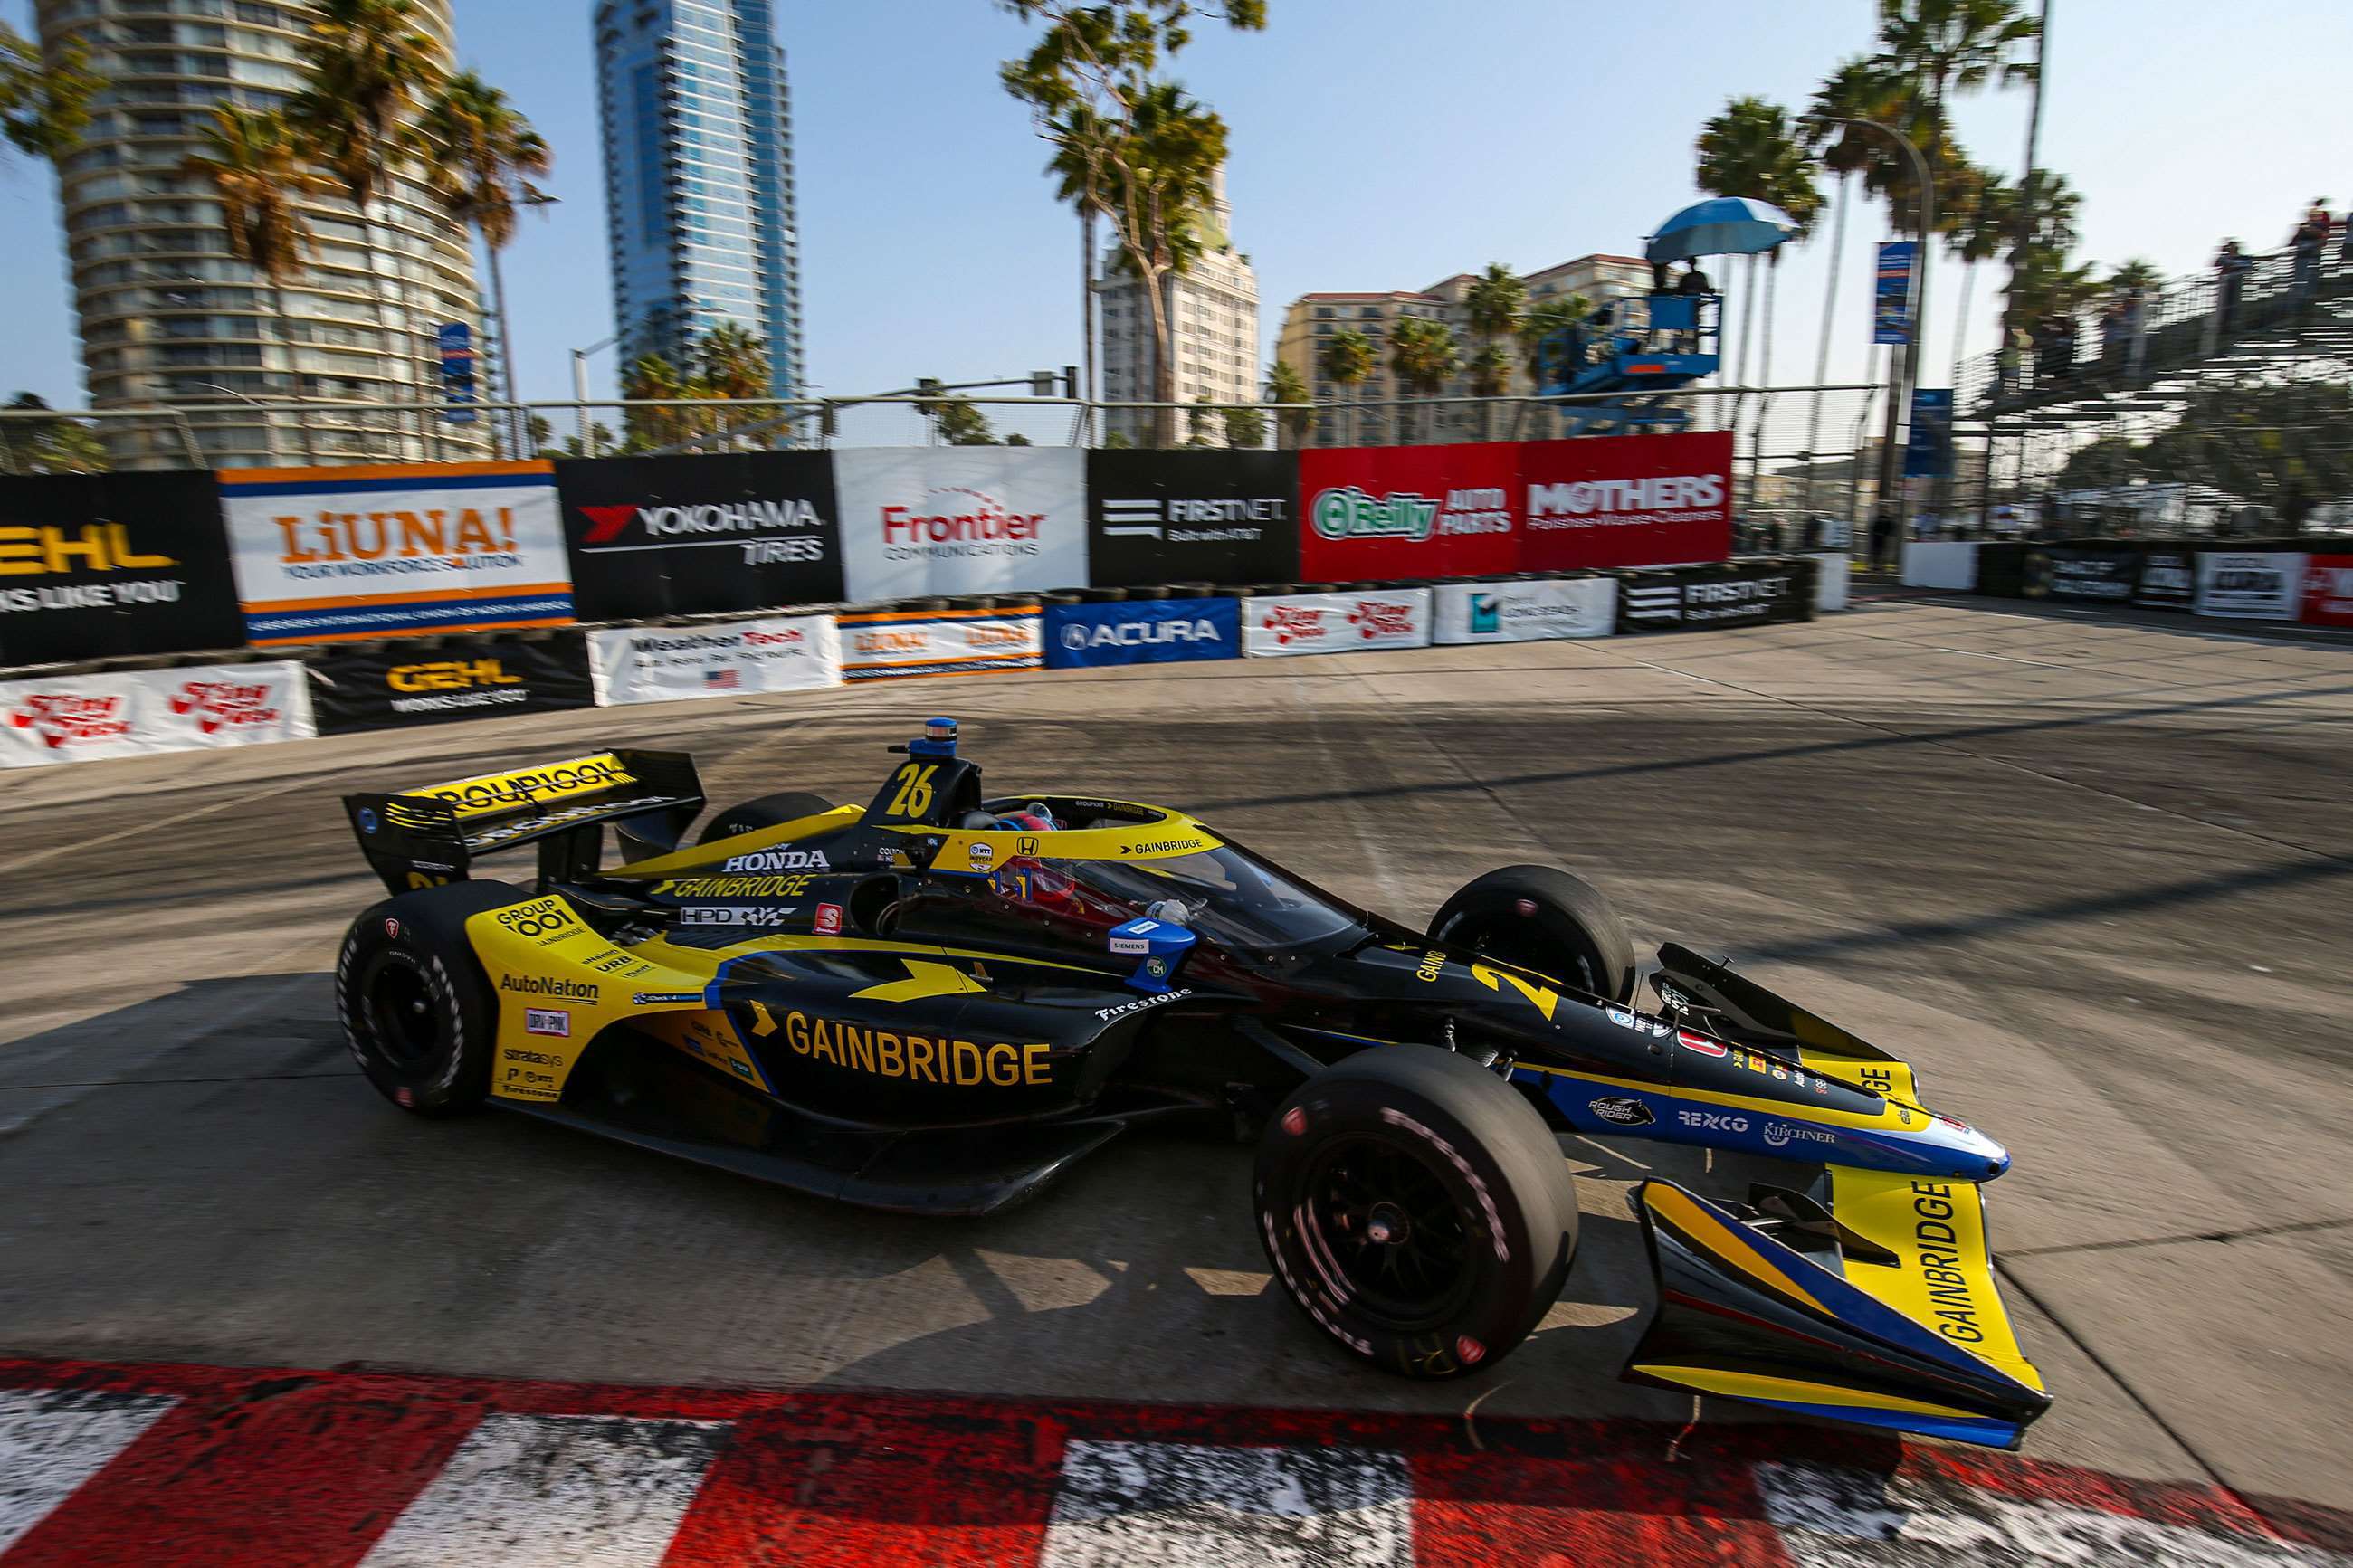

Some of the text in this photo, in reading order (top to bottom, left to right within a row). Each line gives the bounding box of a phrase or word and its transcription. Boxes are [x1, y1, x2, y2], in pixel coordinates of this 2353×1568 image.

[1446, 489, 1506, 510] AUTO
[1527, 474, 1724, 516] MOTHERS
[635, 499, 822, 536] YOKOHAMA
[881, 506, 1049, 544] Frontier
[1438, 511, 1512, 536] PARTS
[274, 507, 519, 563] LiUNA!
[0, 522, 179, 575] EHL
[740, 539, 824, 565] TIRES
[1088, 619, 1222, 647] ACURA
[386, 659, 524, 693] GEHL
[434, 761, 615, 813] ROUP1001
[885, 763, 939, 819] 26
[1135, 839, 1203, 855] GAINBRIDGE
[722, 850, 830, 872] HONDA
[674, 874, 816, 898] GAINBRIDGE
[498, 899, 555, 925] GROUP
[682, 909, 724, 923] HPD
[1114, 942, 1145, 950] SIEMENS
[500, 974, 599, 999] AutoNation
[1471, 955, 1564, 1022] 2
[1094, 988, 1193, 1021] Firestone
[786, 1011, 1053, 1086] GAINBRIDGE
[1588, 1100, 1632, 1114] ROUGH
[1596, 1108, 1633, 1121] RIDER
[1678, 1110, 1748, 1132] REXCO
[1764, 1123, 1835, 1144] KIRCHNER
[1911, 1181, 1984, 1343] GAINBRIDGE
